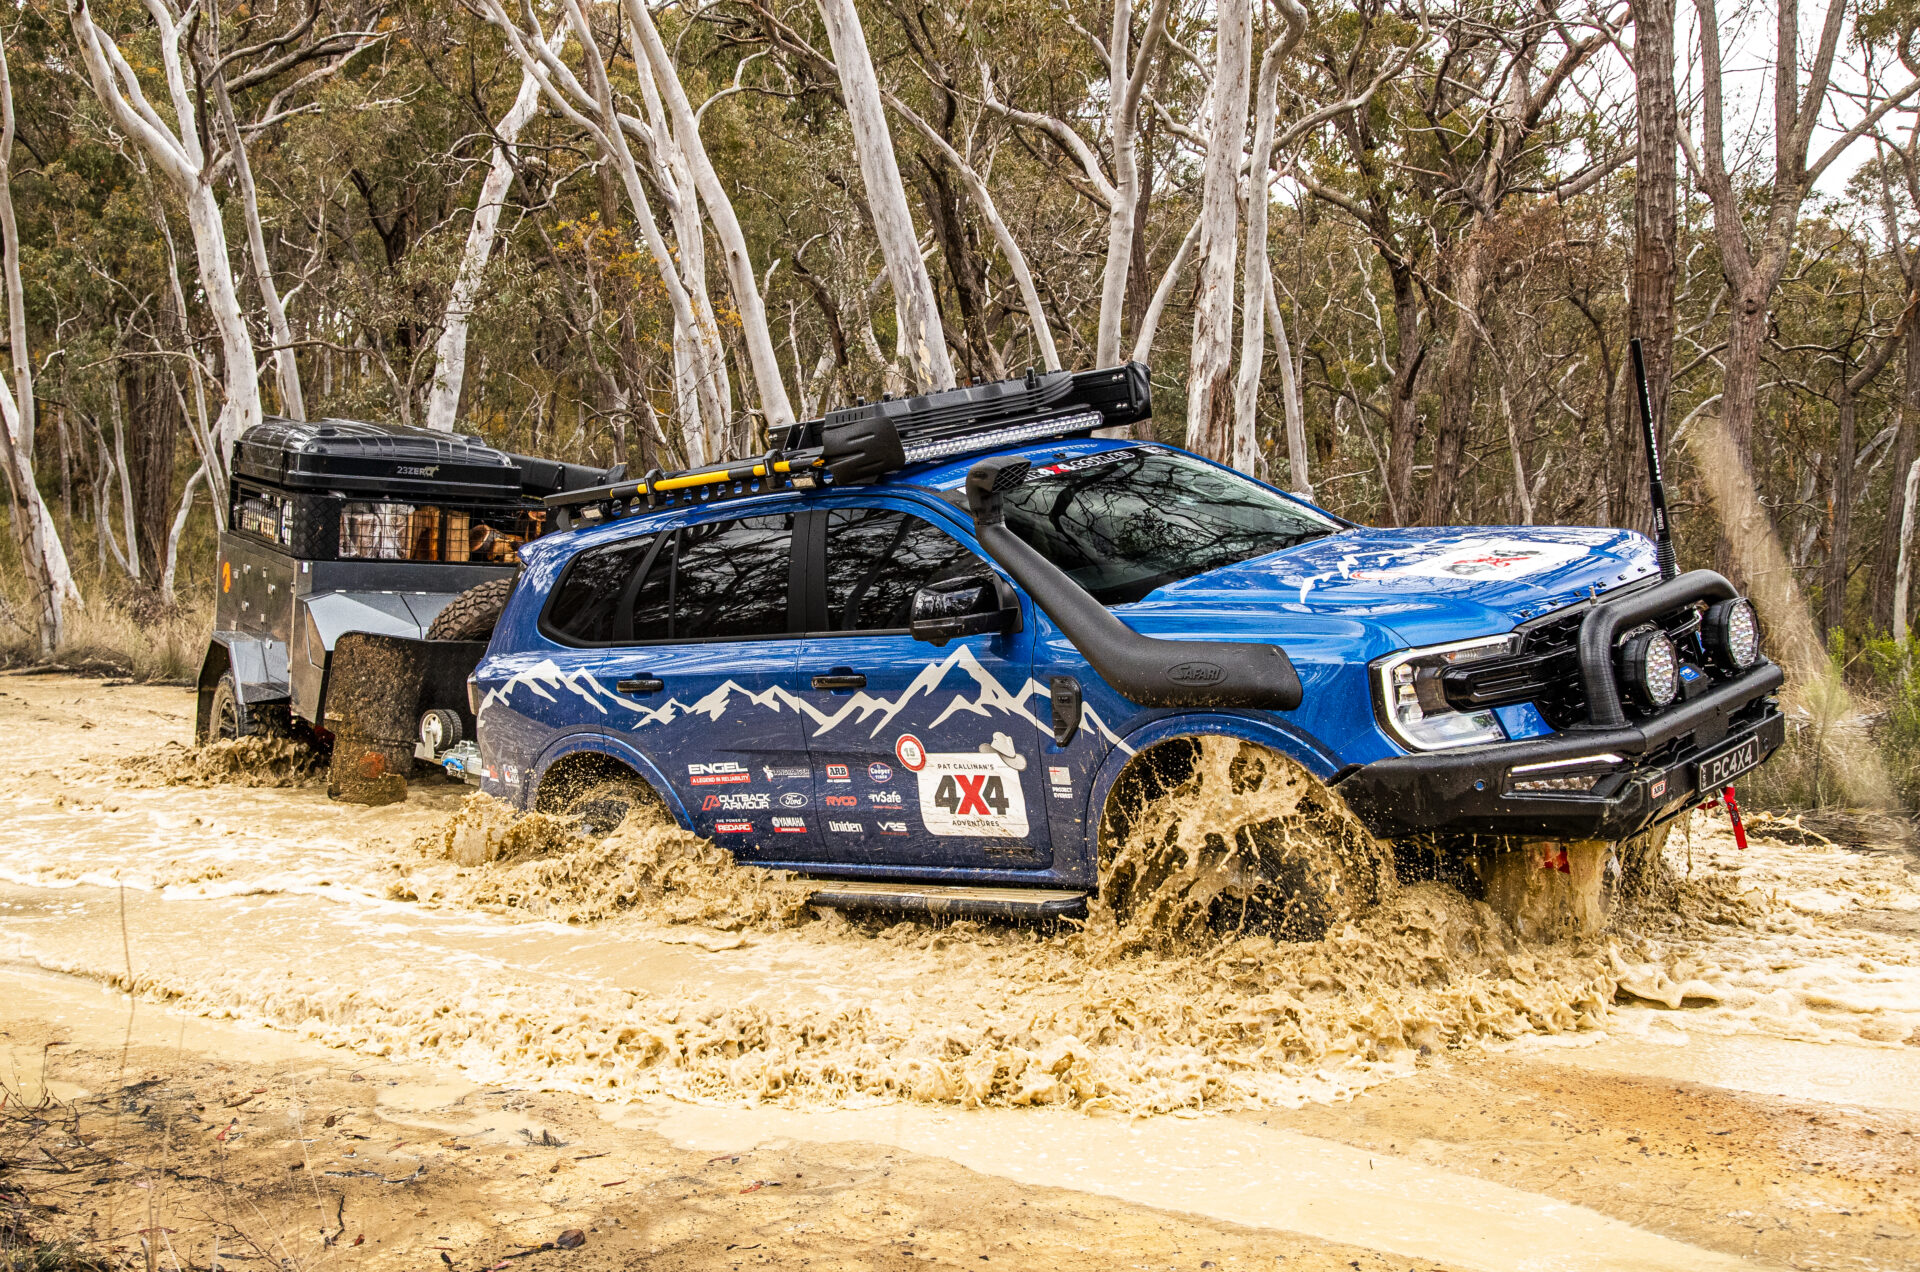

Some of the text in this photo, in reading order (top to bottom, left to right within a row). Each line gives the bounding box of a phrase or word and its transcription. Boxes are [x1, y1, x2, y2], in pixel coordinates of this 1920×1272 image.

[1172, 665, 1221, 681] SAFARI
[687, 762, 748, 775] ENGEL
[1713, 744, 1753, 783] PC4X4
[829, 767, 847, 776] ARB
[870, 767, 891, 775] Cooper
[718, 793, 772, 802] OUTBACK
[784, 794, 802, 805] Ford
[934, 775, 1010, 815] 4X4
[722, 801, 770, 810] ARMOUR
[826, 796, 858, 806] RYCO
[779, 817, 806, 827] YAMAHA
[828, 820, 863, 832] Uniden
[877, 821, 908, 832] VRS
